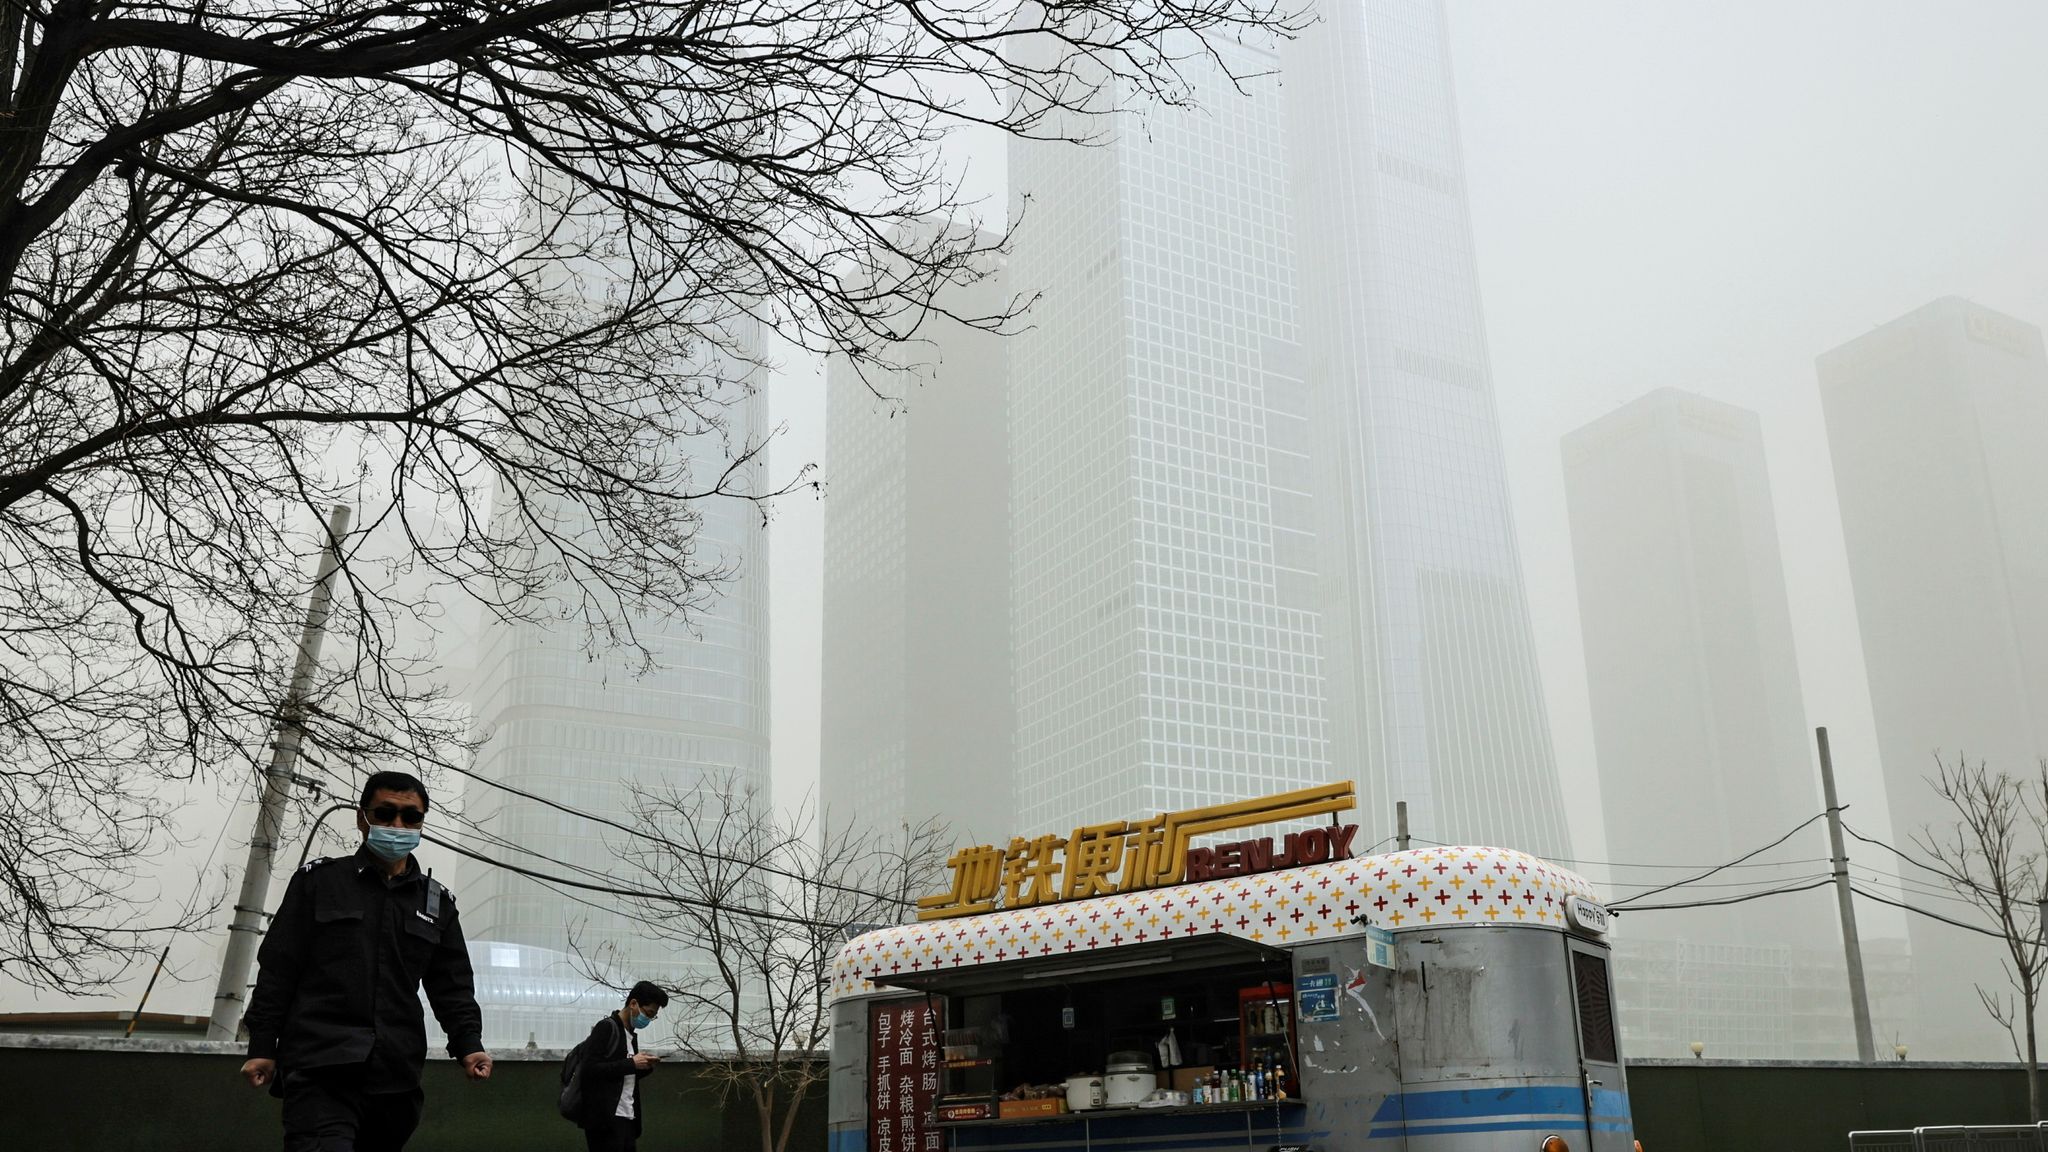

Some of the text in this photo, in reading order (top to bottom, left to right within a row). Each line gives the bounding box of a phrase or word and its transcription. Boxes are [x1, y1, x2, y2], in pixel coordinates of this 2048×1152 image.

[1184, 823, 1359, 883] RENJOY
[877, 1012, 892, 1152] 包子 手抓饼 凉皮
[899, 1009, 916, 1152] 烤冷面 杂粮煎饼
[921, 1007, 937, 1091] 台式烤肠
